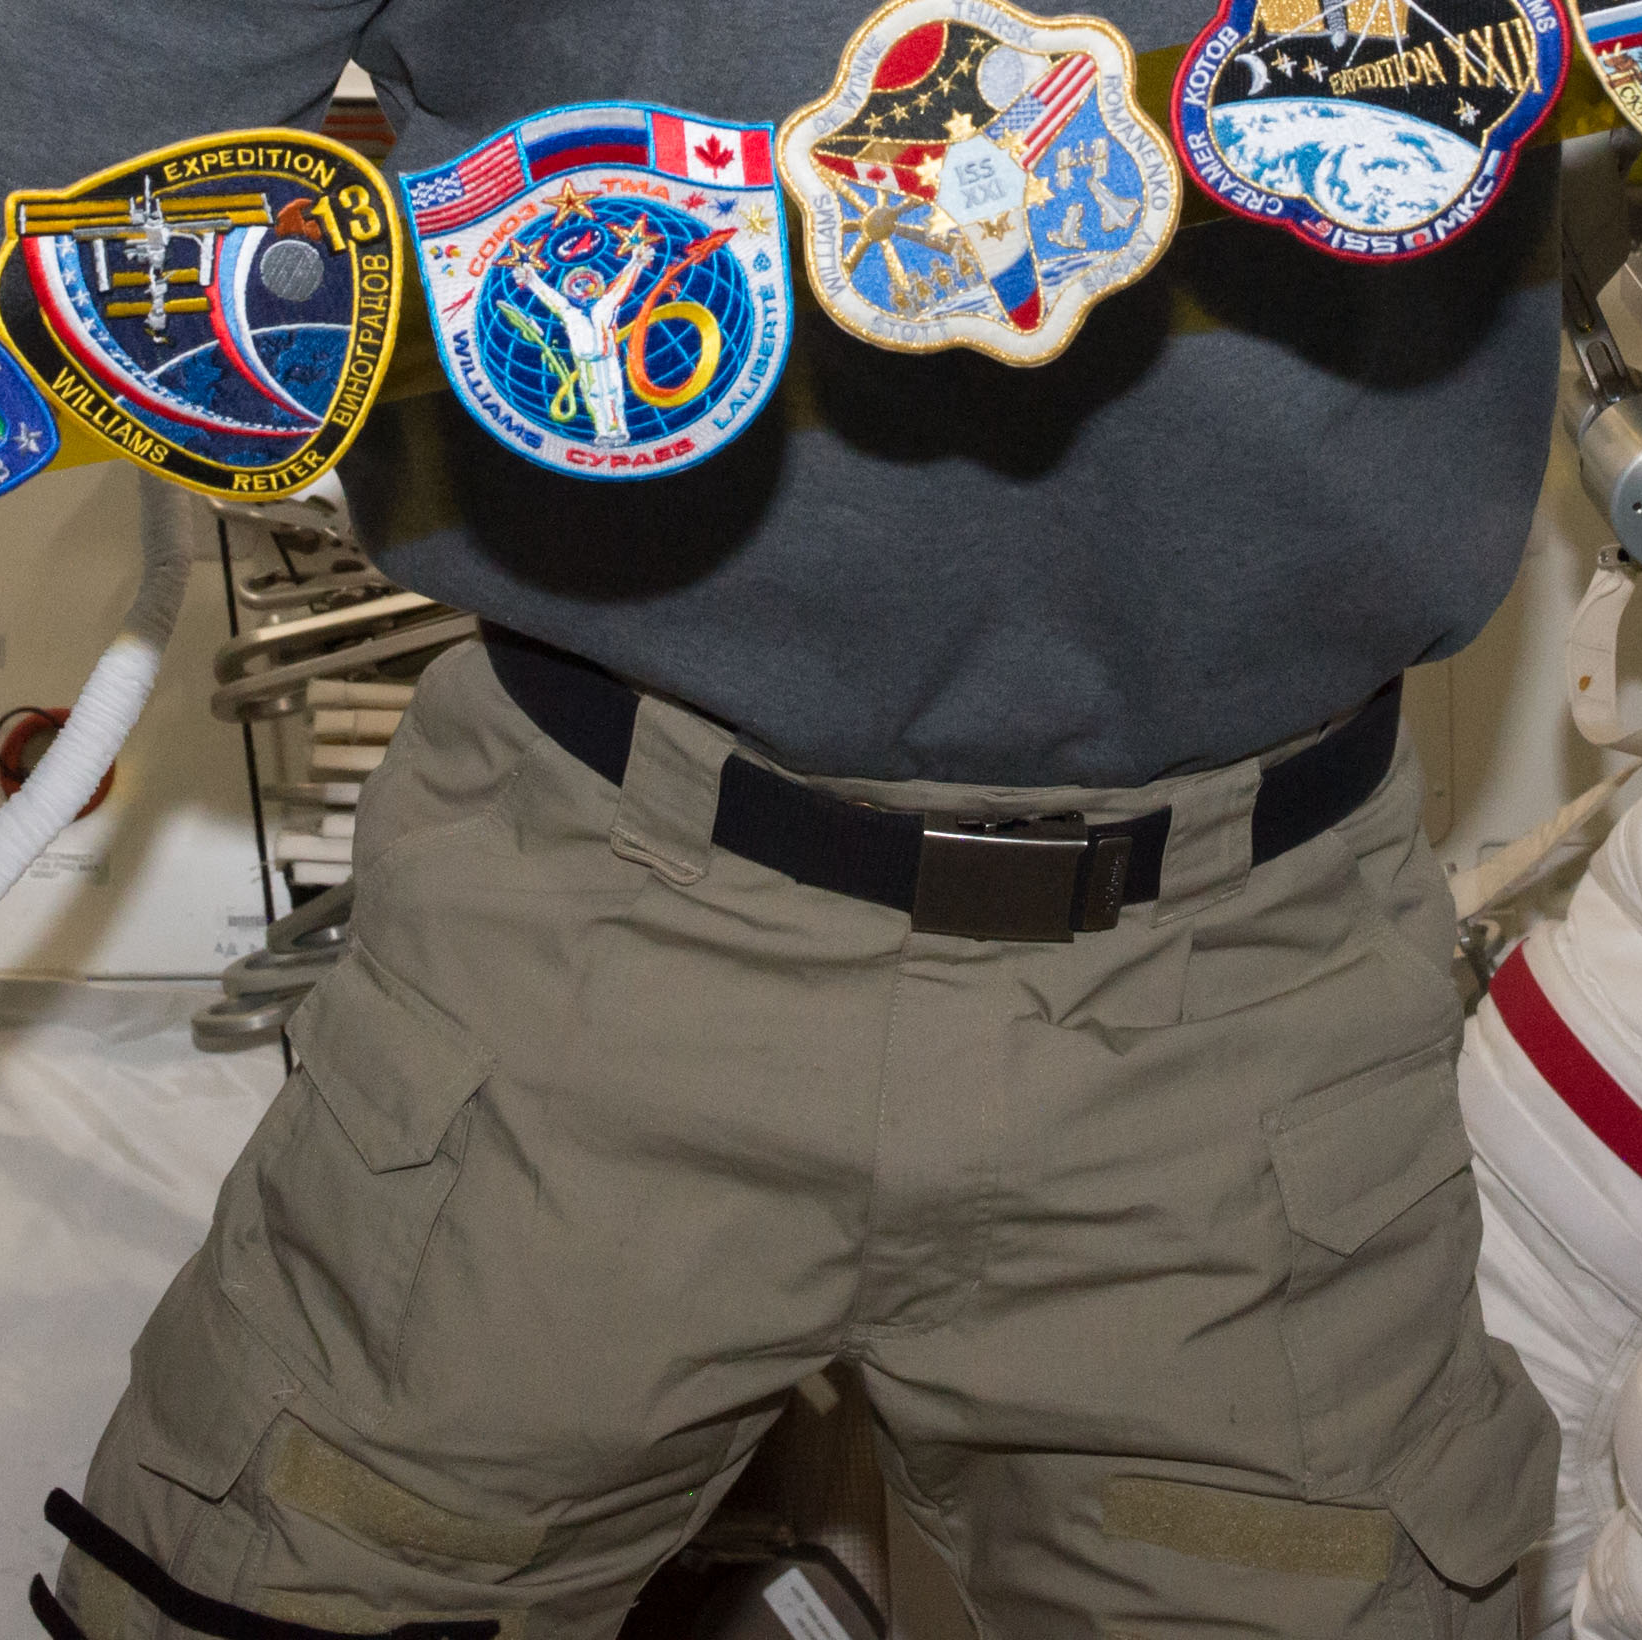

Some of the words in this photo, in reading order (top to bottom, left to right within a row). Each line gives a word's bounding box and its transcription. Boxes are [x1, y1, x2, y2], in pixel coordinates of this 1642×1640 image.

[1329, 40, 1447, 96] EXPEDITION
[163, 148, 338, 187] EXPEDITION
[957, 159, 994, 186] ISS
[1102, 72, 1169, 211] ROMANENKO
[963, 180, 1007, 210] XXI
[1192, 133, 1285, 216] CREAMER
[311, 184, 381, 253] 13
[814, 193, 848, 298] WILLIAMS
[332, 251, 391, 429] ВИНОГРАДОВ
[870, 315, 949, 344] STOTT
[51, 365, 170, 463] WILLIAMS
[451, 329, 545, 451] WILLIAMS
[232, 449, 326, 492] REITER
[565, 436, 697, 470] СУРАЕВ
